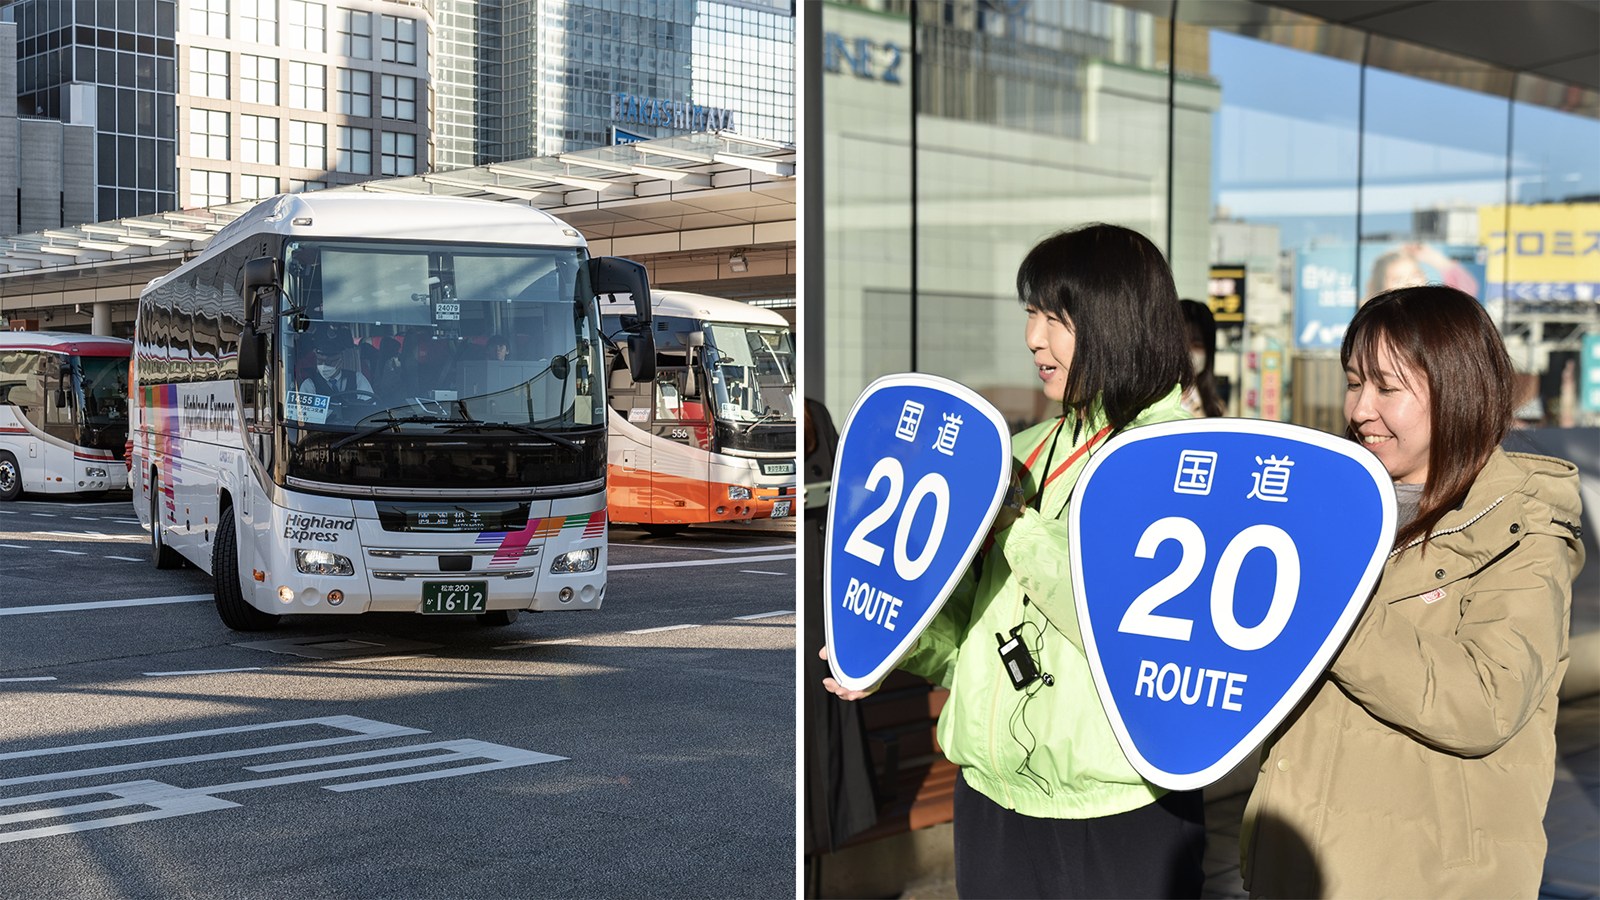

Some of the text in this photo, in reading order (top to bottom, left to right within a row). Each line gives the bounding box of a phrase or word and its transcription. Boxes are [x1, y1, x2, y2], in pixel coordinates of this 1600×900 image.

[882, 41, 902, 85] 2
[616, 93, 736, 132] TAKASHIMAYA
[671, 429, 688, 438] 556
[895, 399, 963, 456] 国道
[1173, 449, 1295, 503] 国道
[283, 526, 339, 543] Express
[285, 513, 355, 531] Highland
[844, 457, 950, 581] 20
[437, 592, 483, 611] 16-12
[842, 577, 903, 632] ROUTE
[1117, 516, 1301, 651] 20
[1134, 659, 1248, 712] ROUTE
